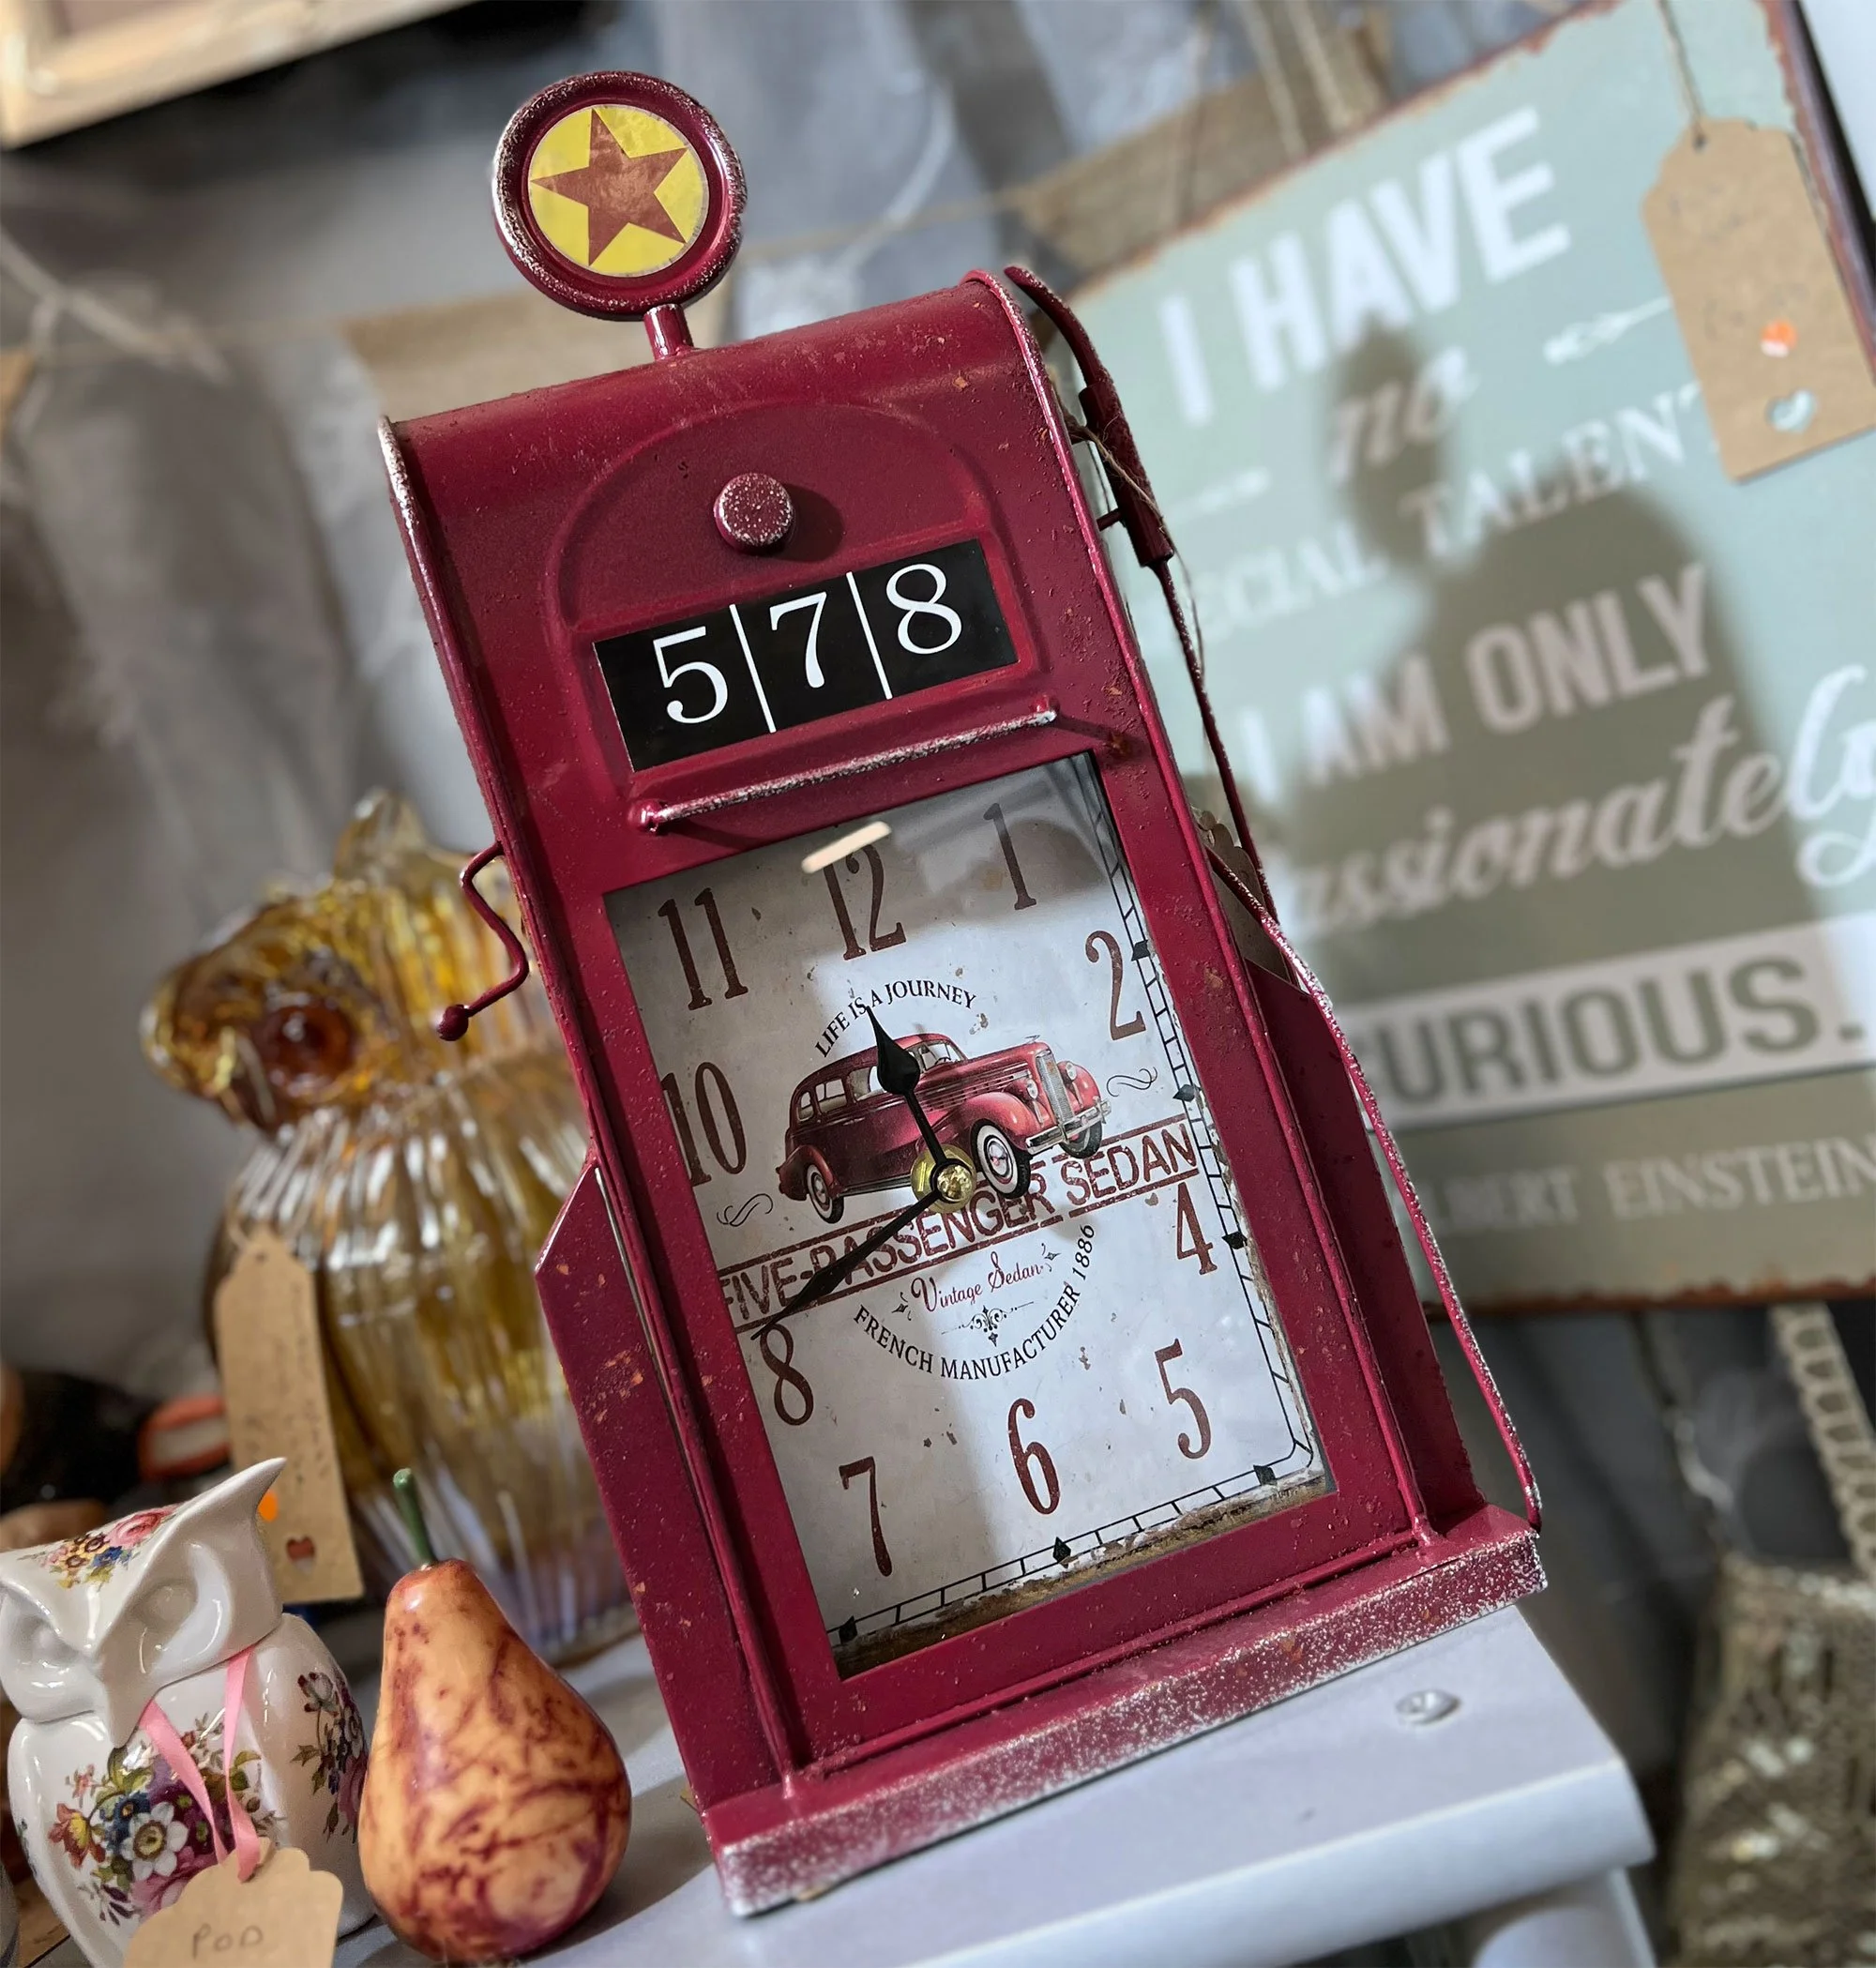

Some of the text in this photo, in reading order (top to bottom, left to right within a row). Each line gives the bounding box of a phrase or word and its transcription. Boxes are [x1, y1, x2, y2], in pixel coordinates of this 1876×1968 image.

[1158, 295, 1214, 428] I
[1229, 105, 1571, 392] HAVE
[1238, 565, 1710, 805] I AM ONLY
[823, 842, 907, 961] 12
[982, 802, 1037, 911] 1
[658, 887, 749, 1010] 11
[1084, 930, 1147, 1042] 2
[814, 979, 977, 1058] LIFE IS A JOURNEY
[1365, 955, 1865, 1107] URIOUS.
[660, 1061, 748, 1187] 10
[1060, 1123, 1197, 1206] SEDAN
[910, 1250, 1042, 1312] Vintage Sedan
[1176, 1181, 1218, 1276] 4
[853, 1224, 1096, 1380] FRENCH MANUFACTURER 1886
[758, 1323, 815, 1427] 8
[1154, 1338, 1211, 1461] 5
[1006, 1397, 1061, 1516] 6
[838, 1455, 893, 1578] 7
